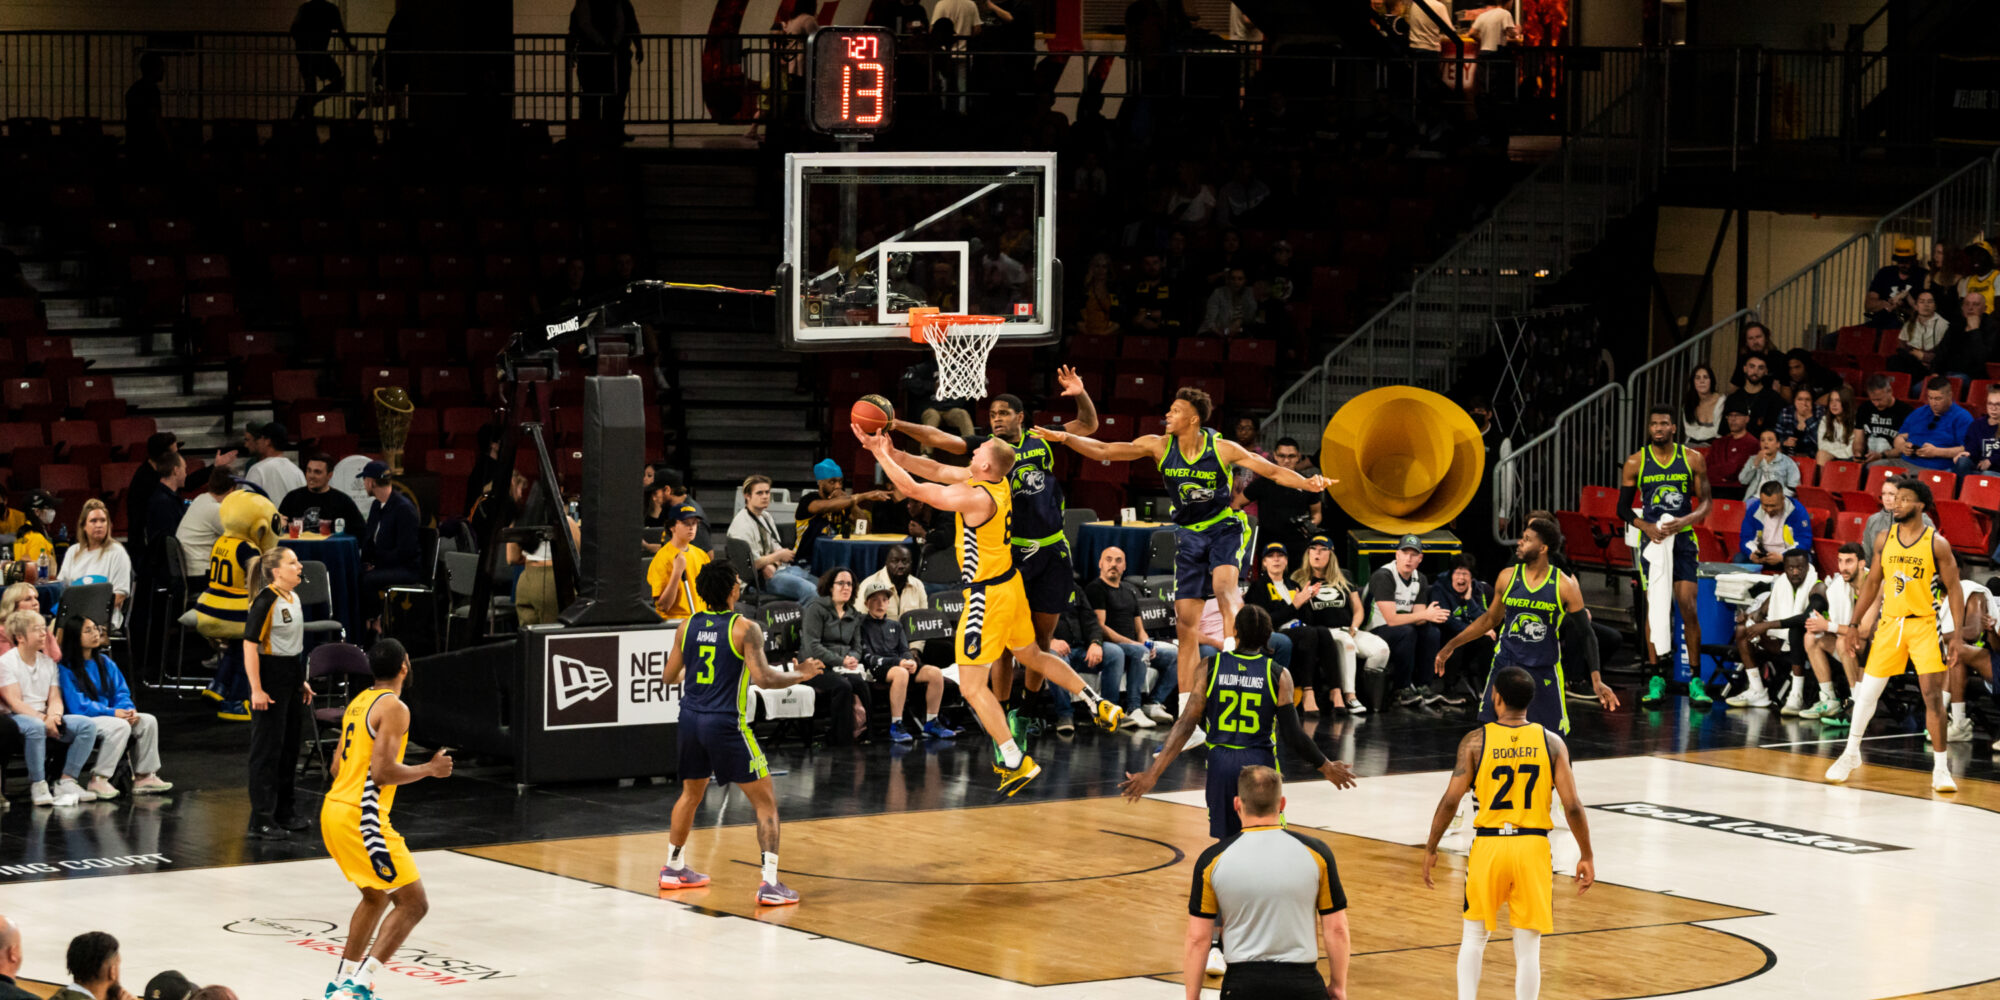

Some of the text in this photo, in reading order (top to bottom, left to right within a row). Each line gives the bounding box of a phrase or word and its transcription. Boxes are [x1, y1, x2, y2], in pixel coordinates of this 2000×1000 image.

[841, 36, 878, 59] 7:27
[842, 62, 884, 123] 13
[546, 315, 580, 341] SPALDING
[1023, 447, 1046, 459] LIONS
[1164, 467, 1217, 480] RIVER LIONS
[1643, 473, 1688, 484] RIVER LIONS
[1681, 481, 1688, 493] 6
[1889, 556, 1924, 566] STINGERS
[210, 556, 233, 587] 00
[1912, 567, 1925, 579] 21
[1505, 597, 1557, 611] RIVER LIONS
[774, 611, 801, 623] HUFF
[1141, 609, 1168, 620] HUFF
[1548, 612, 1554, 625] 1
[916, 619, 943, 631] HUFF
[696, 631, 718, 643] AHMAD
[696, 645, 716, 684] 3
[631, 678, 682, 703] ERA
[1217, 689, 1262, 734] 25
[1492, 747, 1540, 759] BOCKERT
[1489, 764, 1540, 810] 27
[1600, 803, 1884, 852] Foot Locker
[58, 852, 173, 871] COURT
